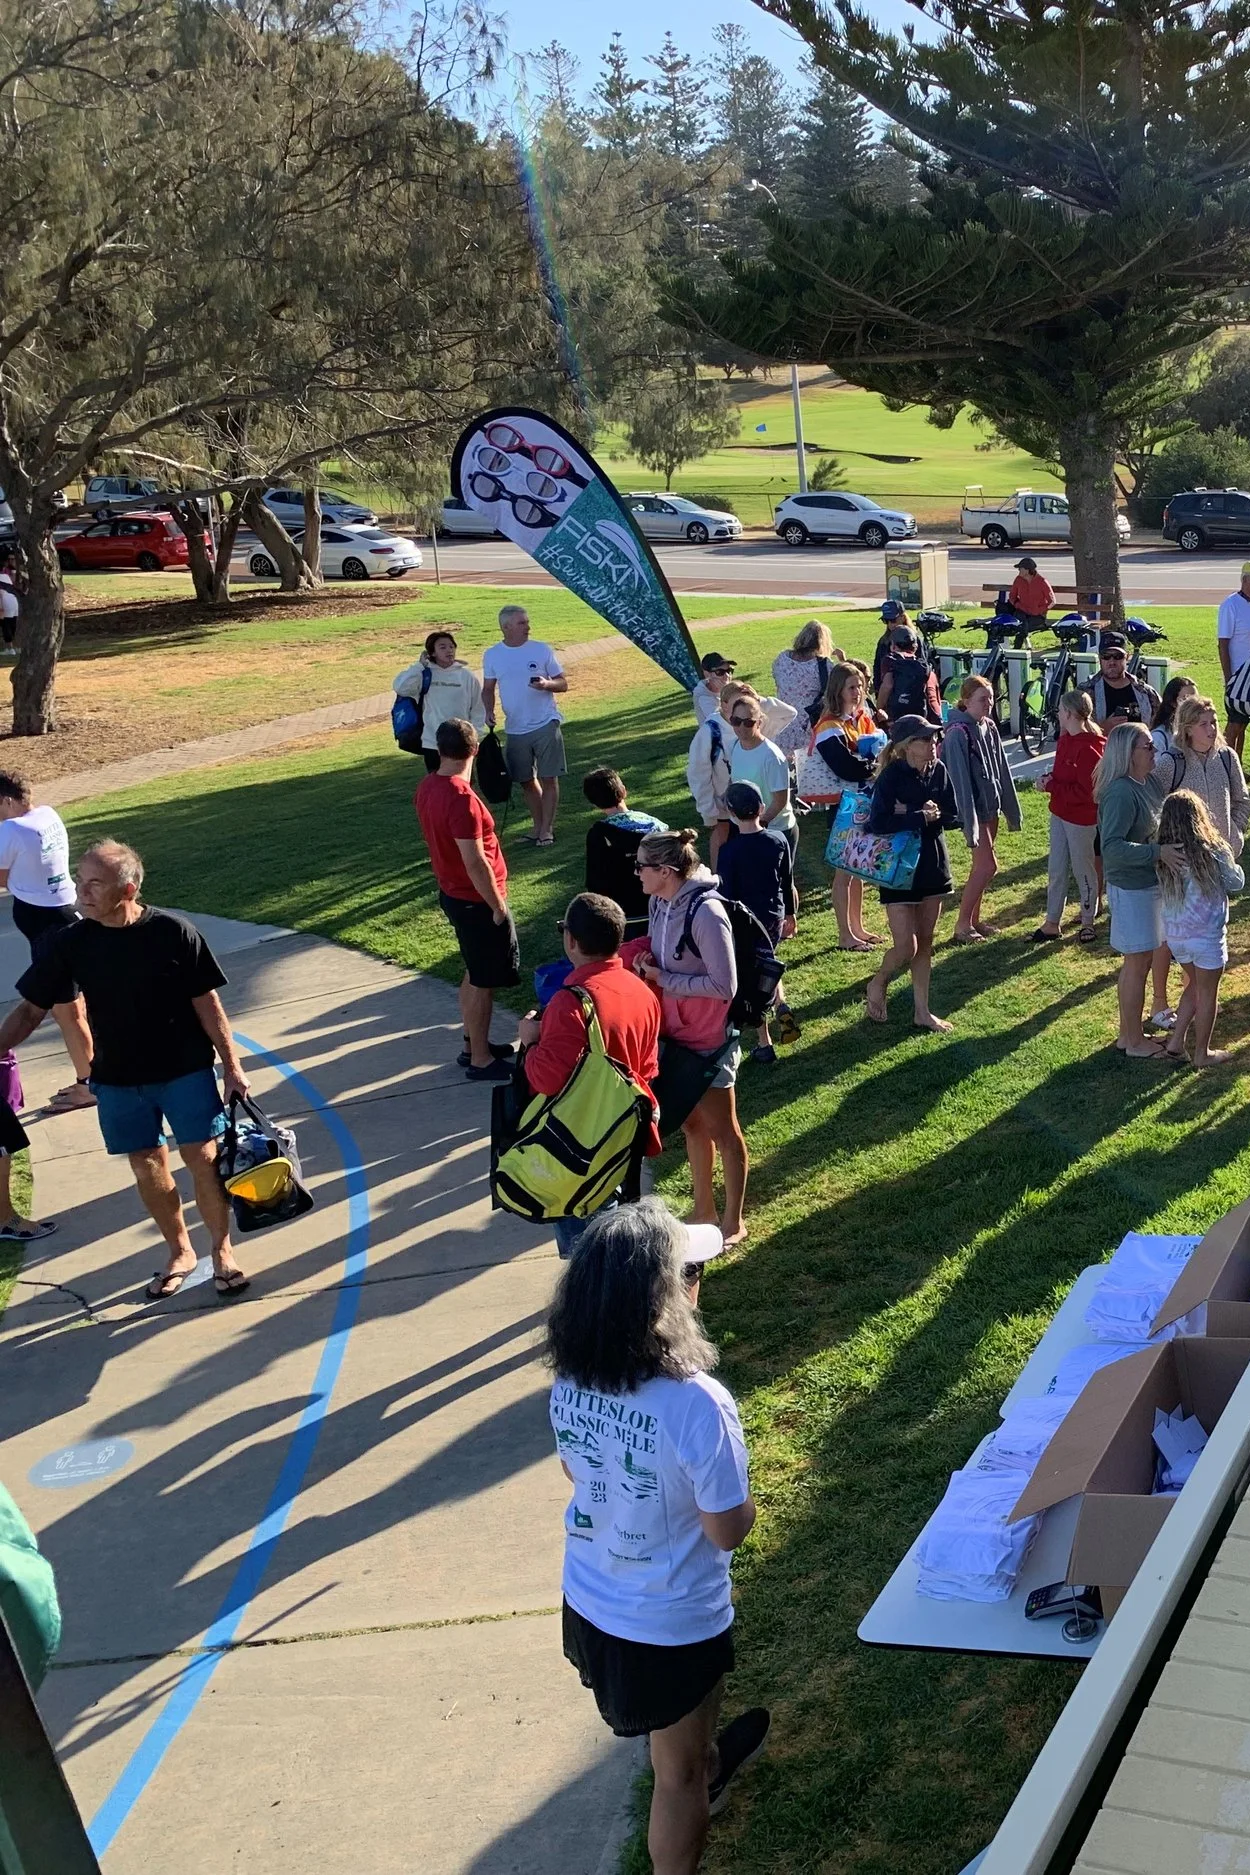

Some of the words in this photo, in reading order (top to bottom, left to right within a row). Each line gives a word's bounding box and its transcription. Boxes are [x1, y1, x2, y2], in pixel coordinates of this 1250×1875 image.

[555, 514, 633, 586] FISKI
[554, 1385, 659, 1436] COTTESLOE
[554, 1405, 610, 1438] CLASSIC
[590, 1480, 606, 1493] 20
[591, 1492, 607, 1504] 23
